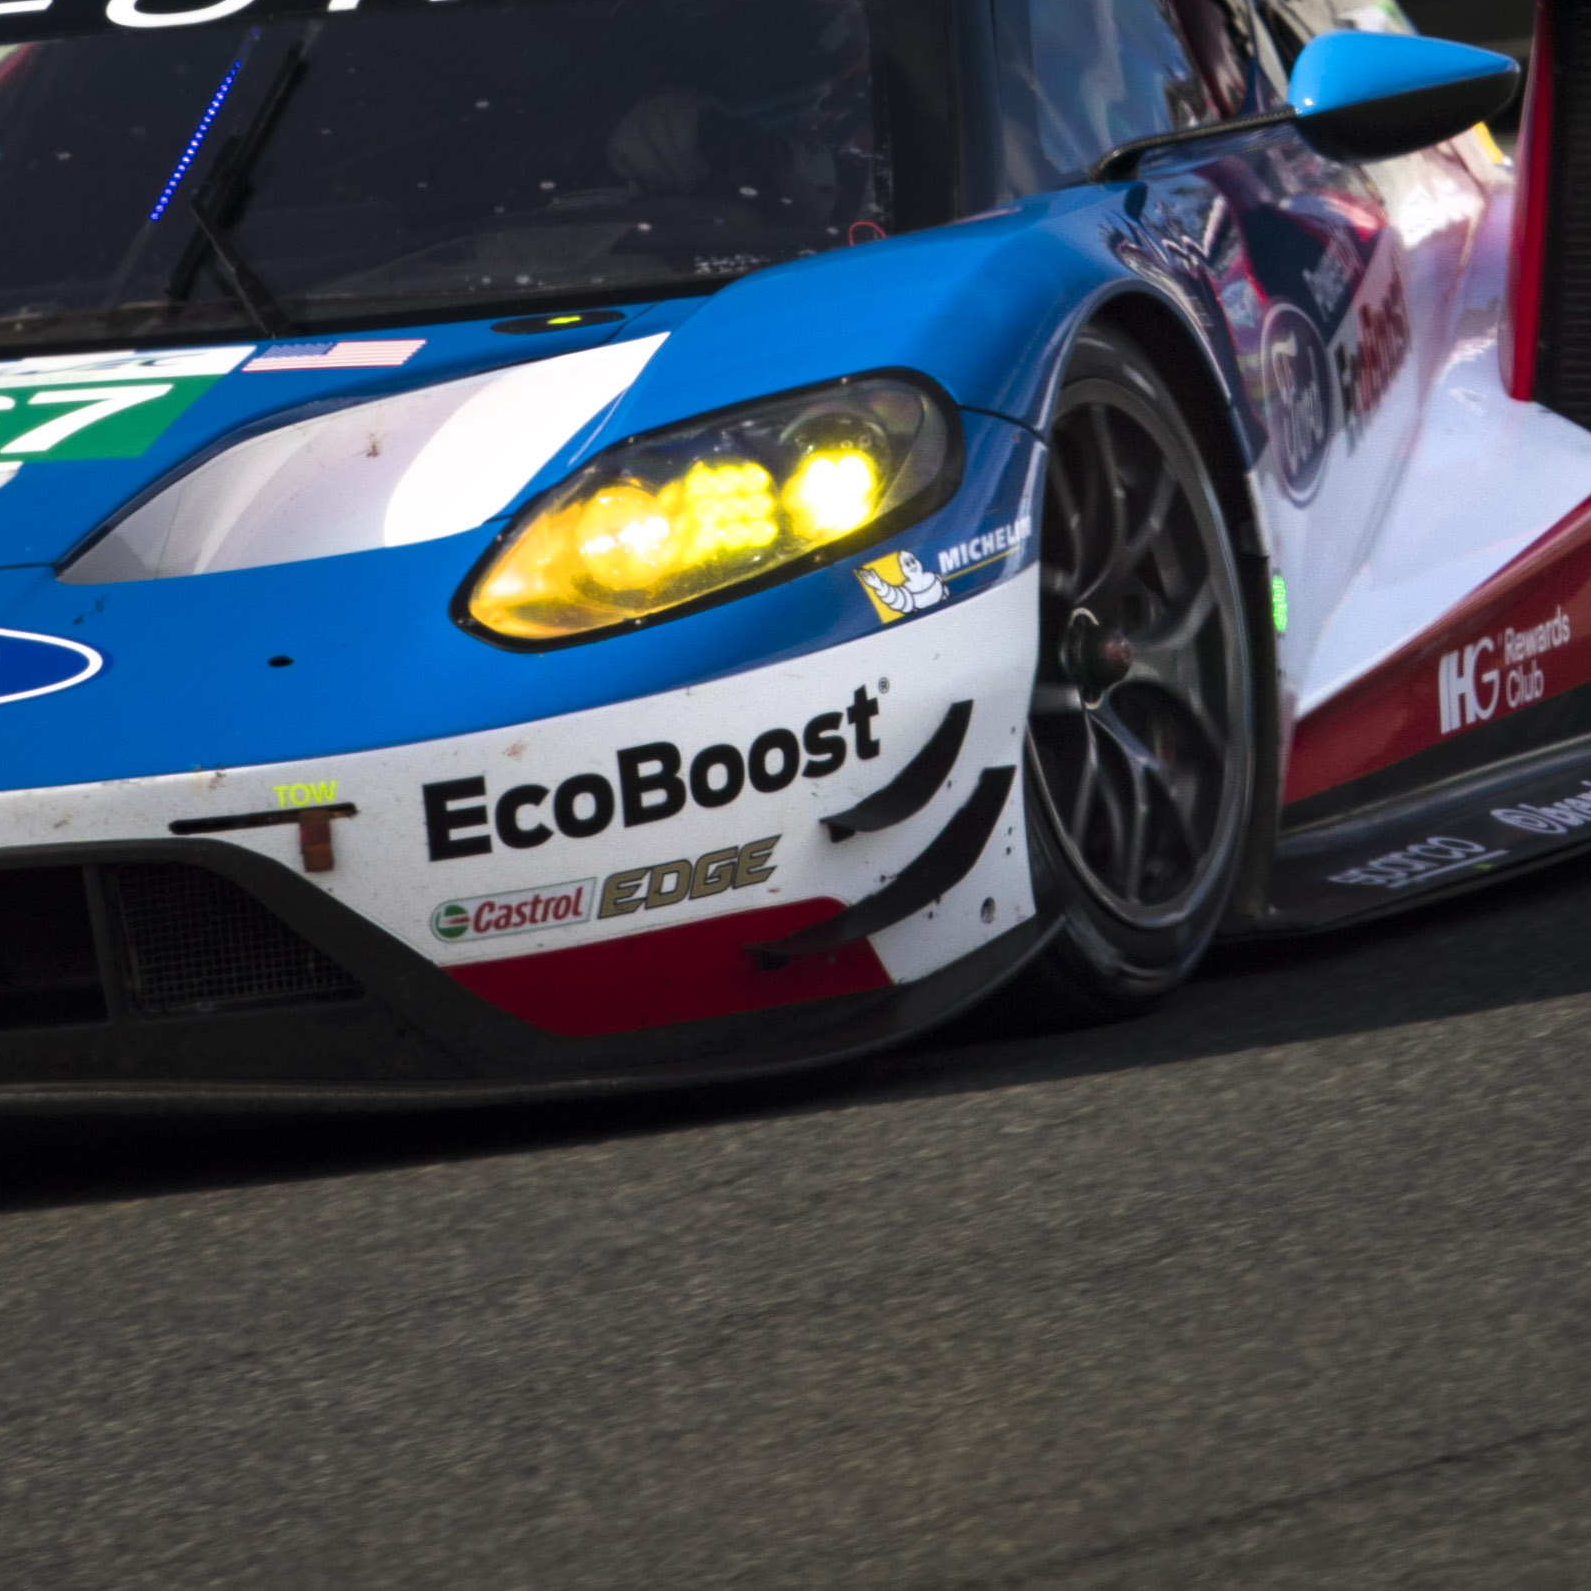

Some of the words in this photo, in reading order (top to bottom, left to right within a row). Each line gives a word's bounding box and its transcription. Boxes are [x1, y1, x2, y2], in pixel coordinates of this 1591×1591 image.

[1439, 636, 1500, 734] IHG
[1504, 605, 1571, 665] Rewards
[1506, 659, 1545, 708] Club
[273, 780, 338, 809] TOW
[472, 884, 583, 933] Castrol
[598, 834, 782, 920] EDGE
